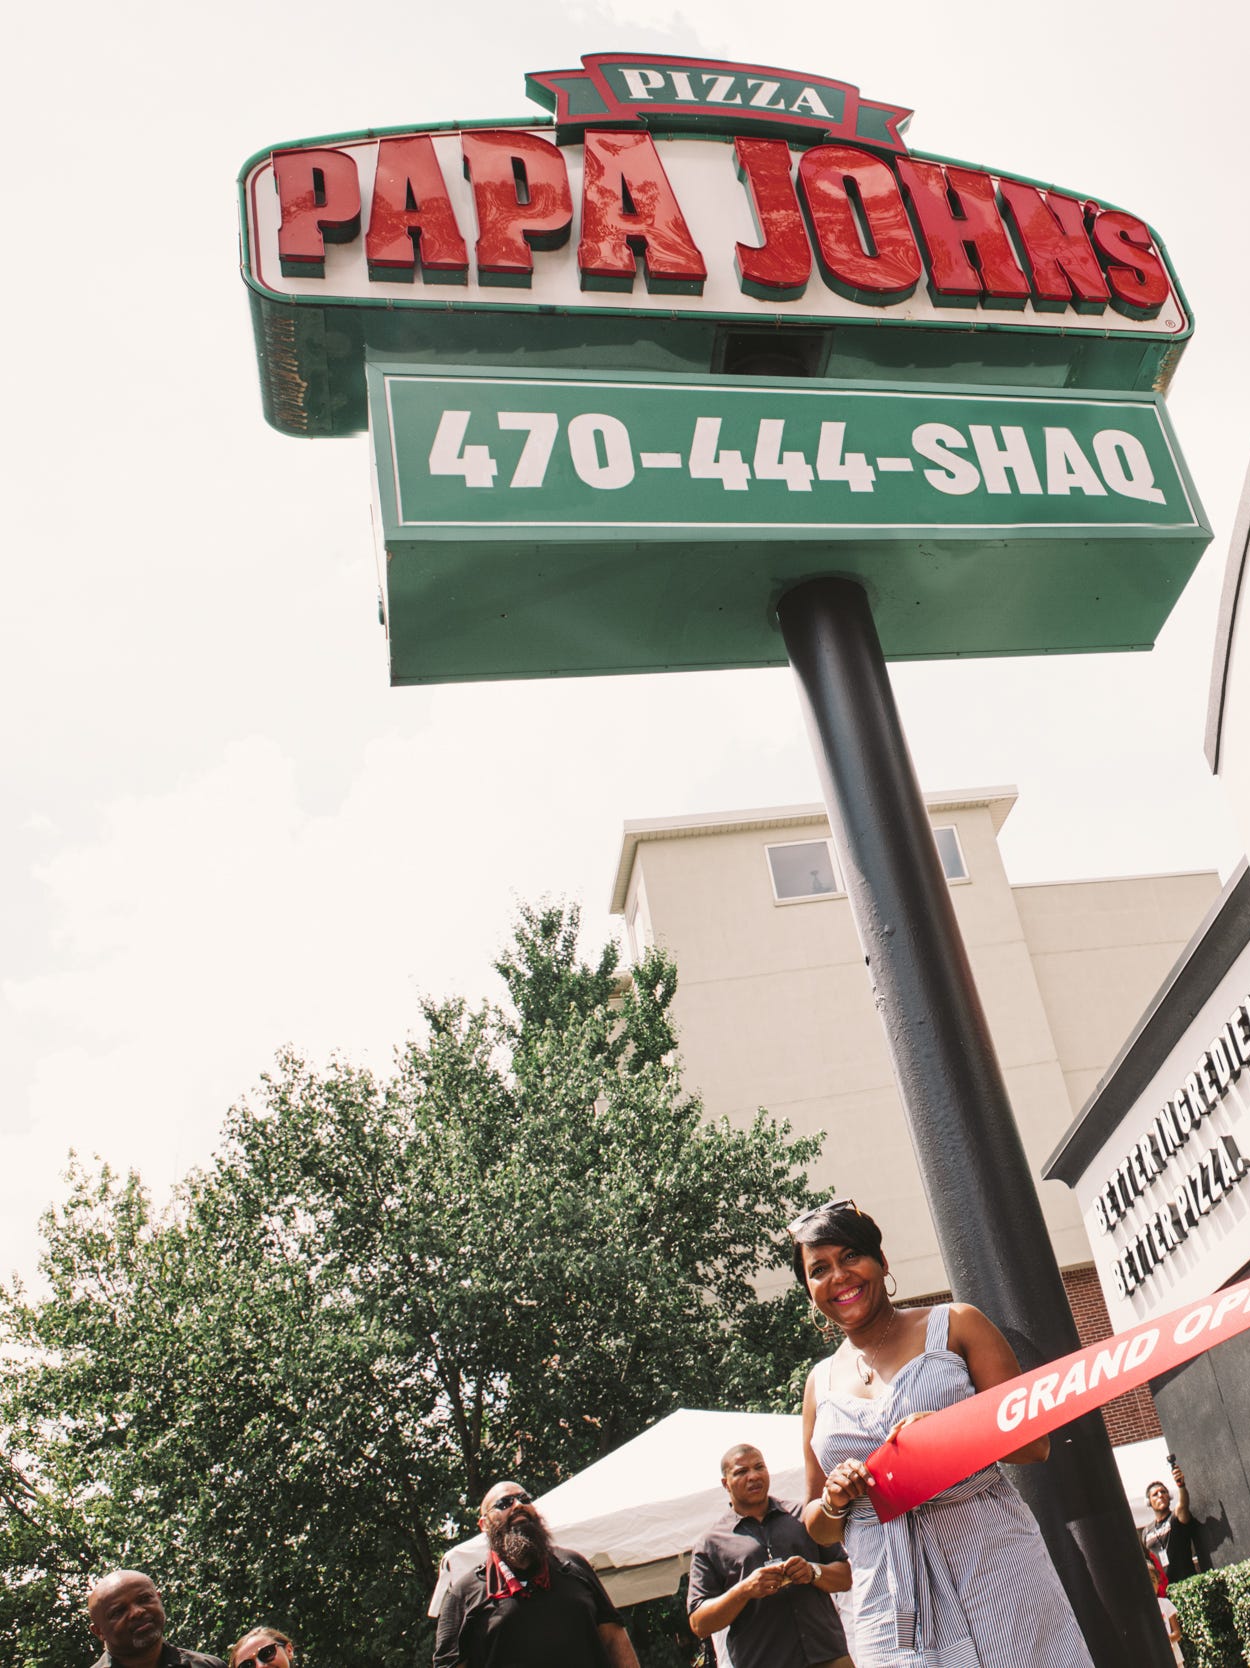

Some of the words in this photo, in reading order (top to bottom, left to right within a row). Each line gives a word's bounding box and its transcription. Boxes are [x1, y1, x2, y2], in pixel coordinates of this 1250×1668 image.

[618, 69, 834, 118] PIZZA
[273, 129, 708, 290] PAPA
[734, 136, 1170, 320] JOHN'S
[429, 410, 1166, 505] 470-444-SHAQ
[1092, 1133, 1168, 1236] BETTER
[1110, 1202, 1188, 1301] BETTER
[996, 1328, 1161, 1433] GRAND
